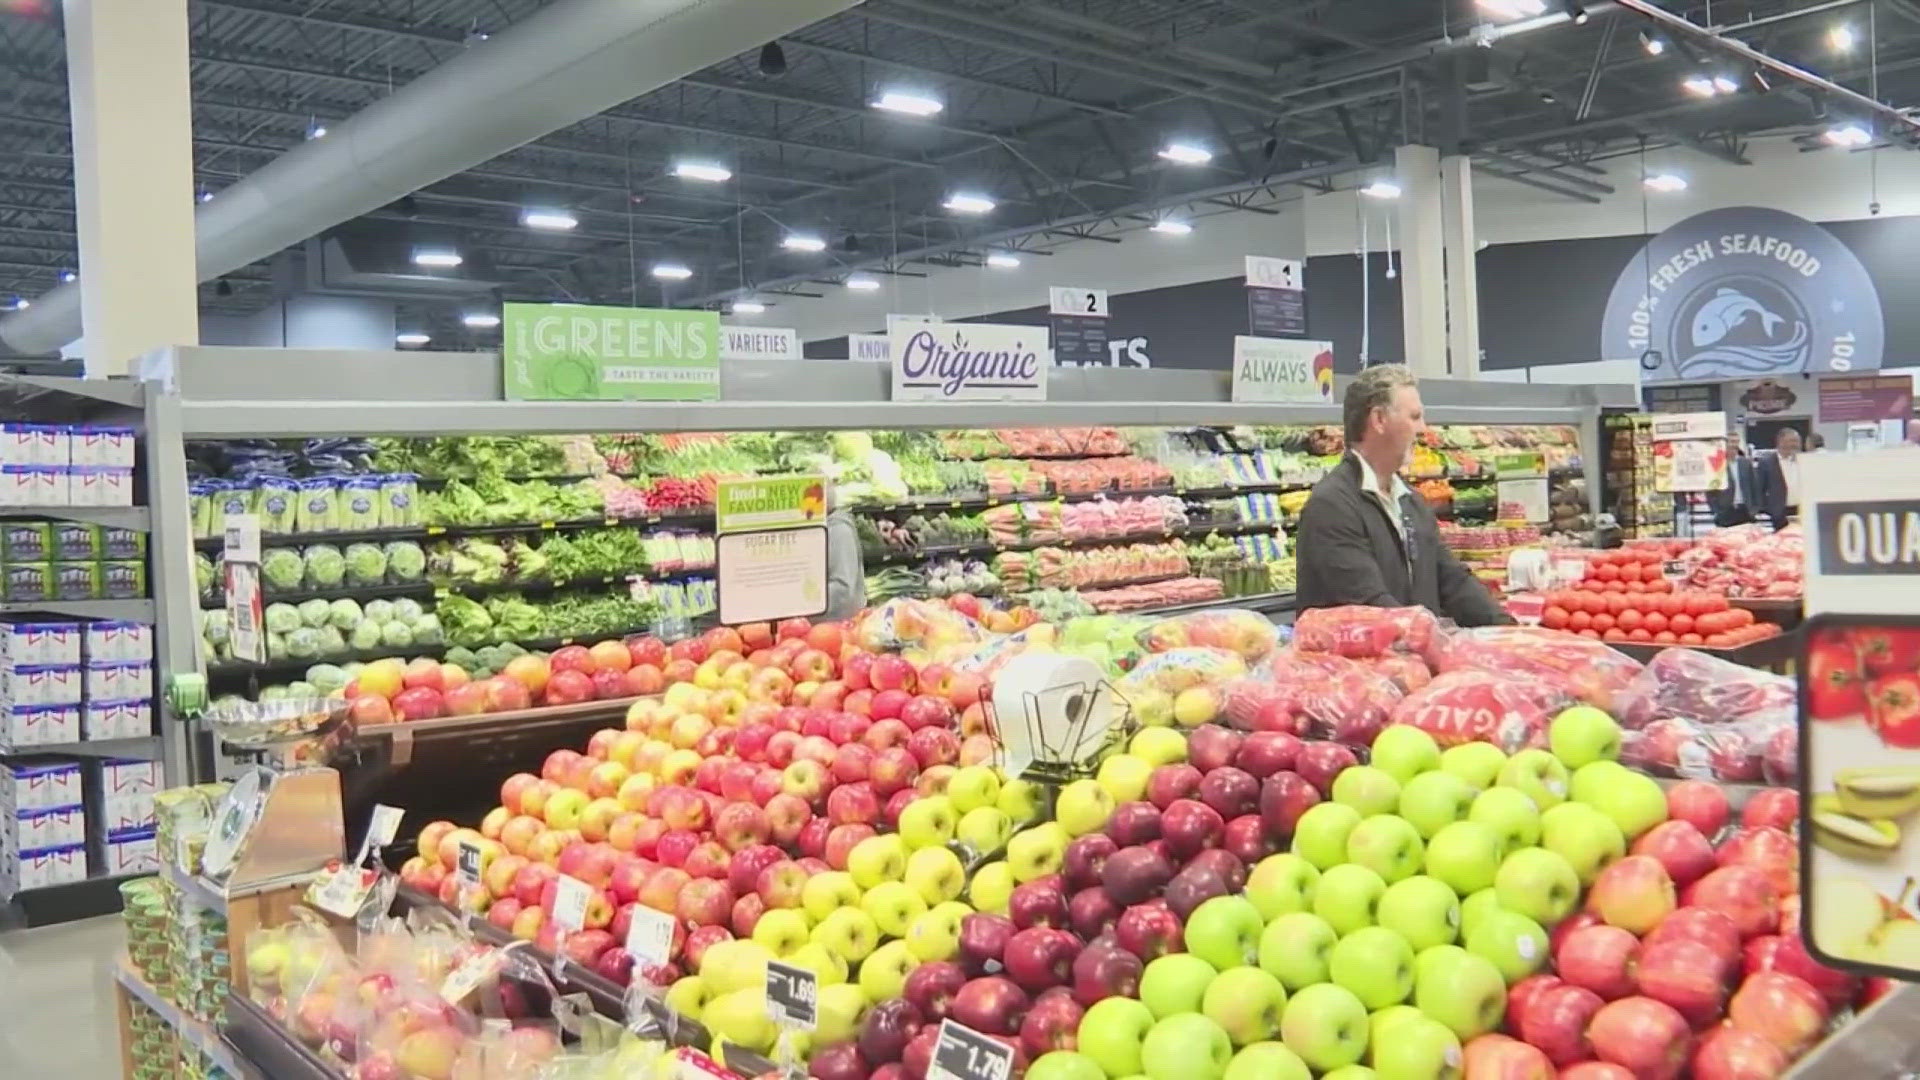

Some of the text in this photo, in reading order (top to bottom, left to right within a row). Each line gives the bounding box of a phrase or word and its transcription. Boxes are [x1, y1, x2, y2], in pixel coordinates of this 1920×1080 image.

[1086, 293, 1097, 313] 2
[1628, 234, 1821, 349] 100% FRESH SEAFOOD
[533, 316, 707, 360] GREENS
[728, 332, 788, 353] VARIETIES
[612, 369, 645, 380] TASTE
[648, 369, 669, 380] THE
[902, 330, 1038, 396] Organic
[1240, 359, 1308, 384] ALWAYS
[769, 484, 800, 499] NEW
[787, 975, 815, 1001] 1.69
[966, 1045, 1006, 1080] 1.79
